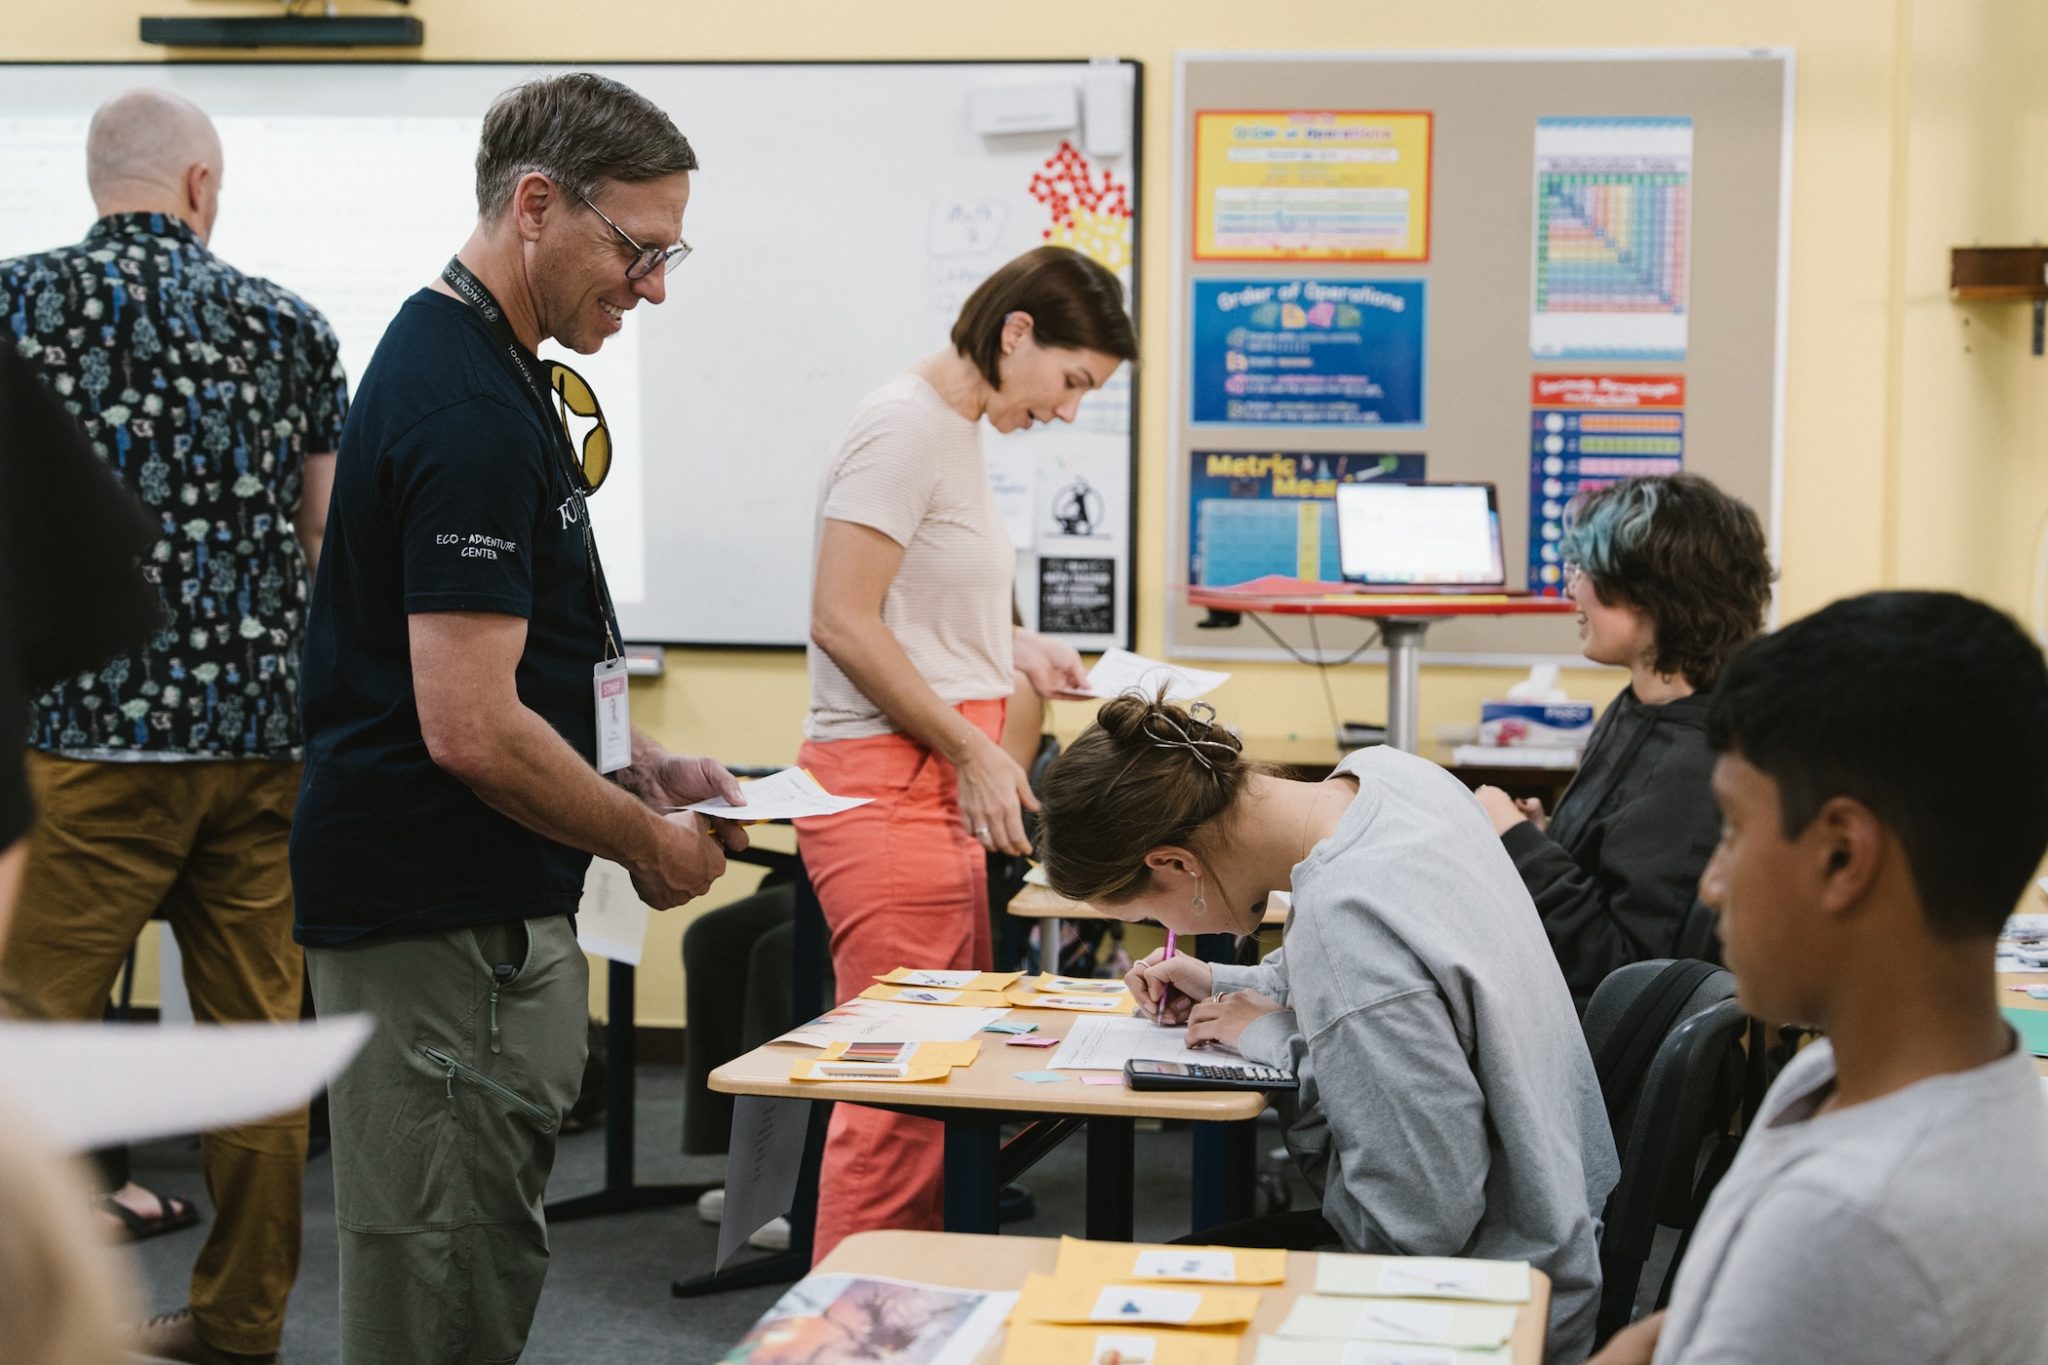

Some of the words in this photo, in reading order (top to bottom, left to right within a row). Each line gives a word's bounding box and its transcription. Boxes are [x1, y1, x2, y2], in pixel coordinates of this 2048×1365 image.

[1217, 286, 1273, 311] Order
[1278, 280, 1300, 301] of
[1304, 280, 1405, 312] Operations
[1206, 453, 1296, 477] Metric
[436, 534, 458, 544] ECO
[468, 534, 516, 552] ADVENTURE
[461, 547, 497, 560] CENTER
